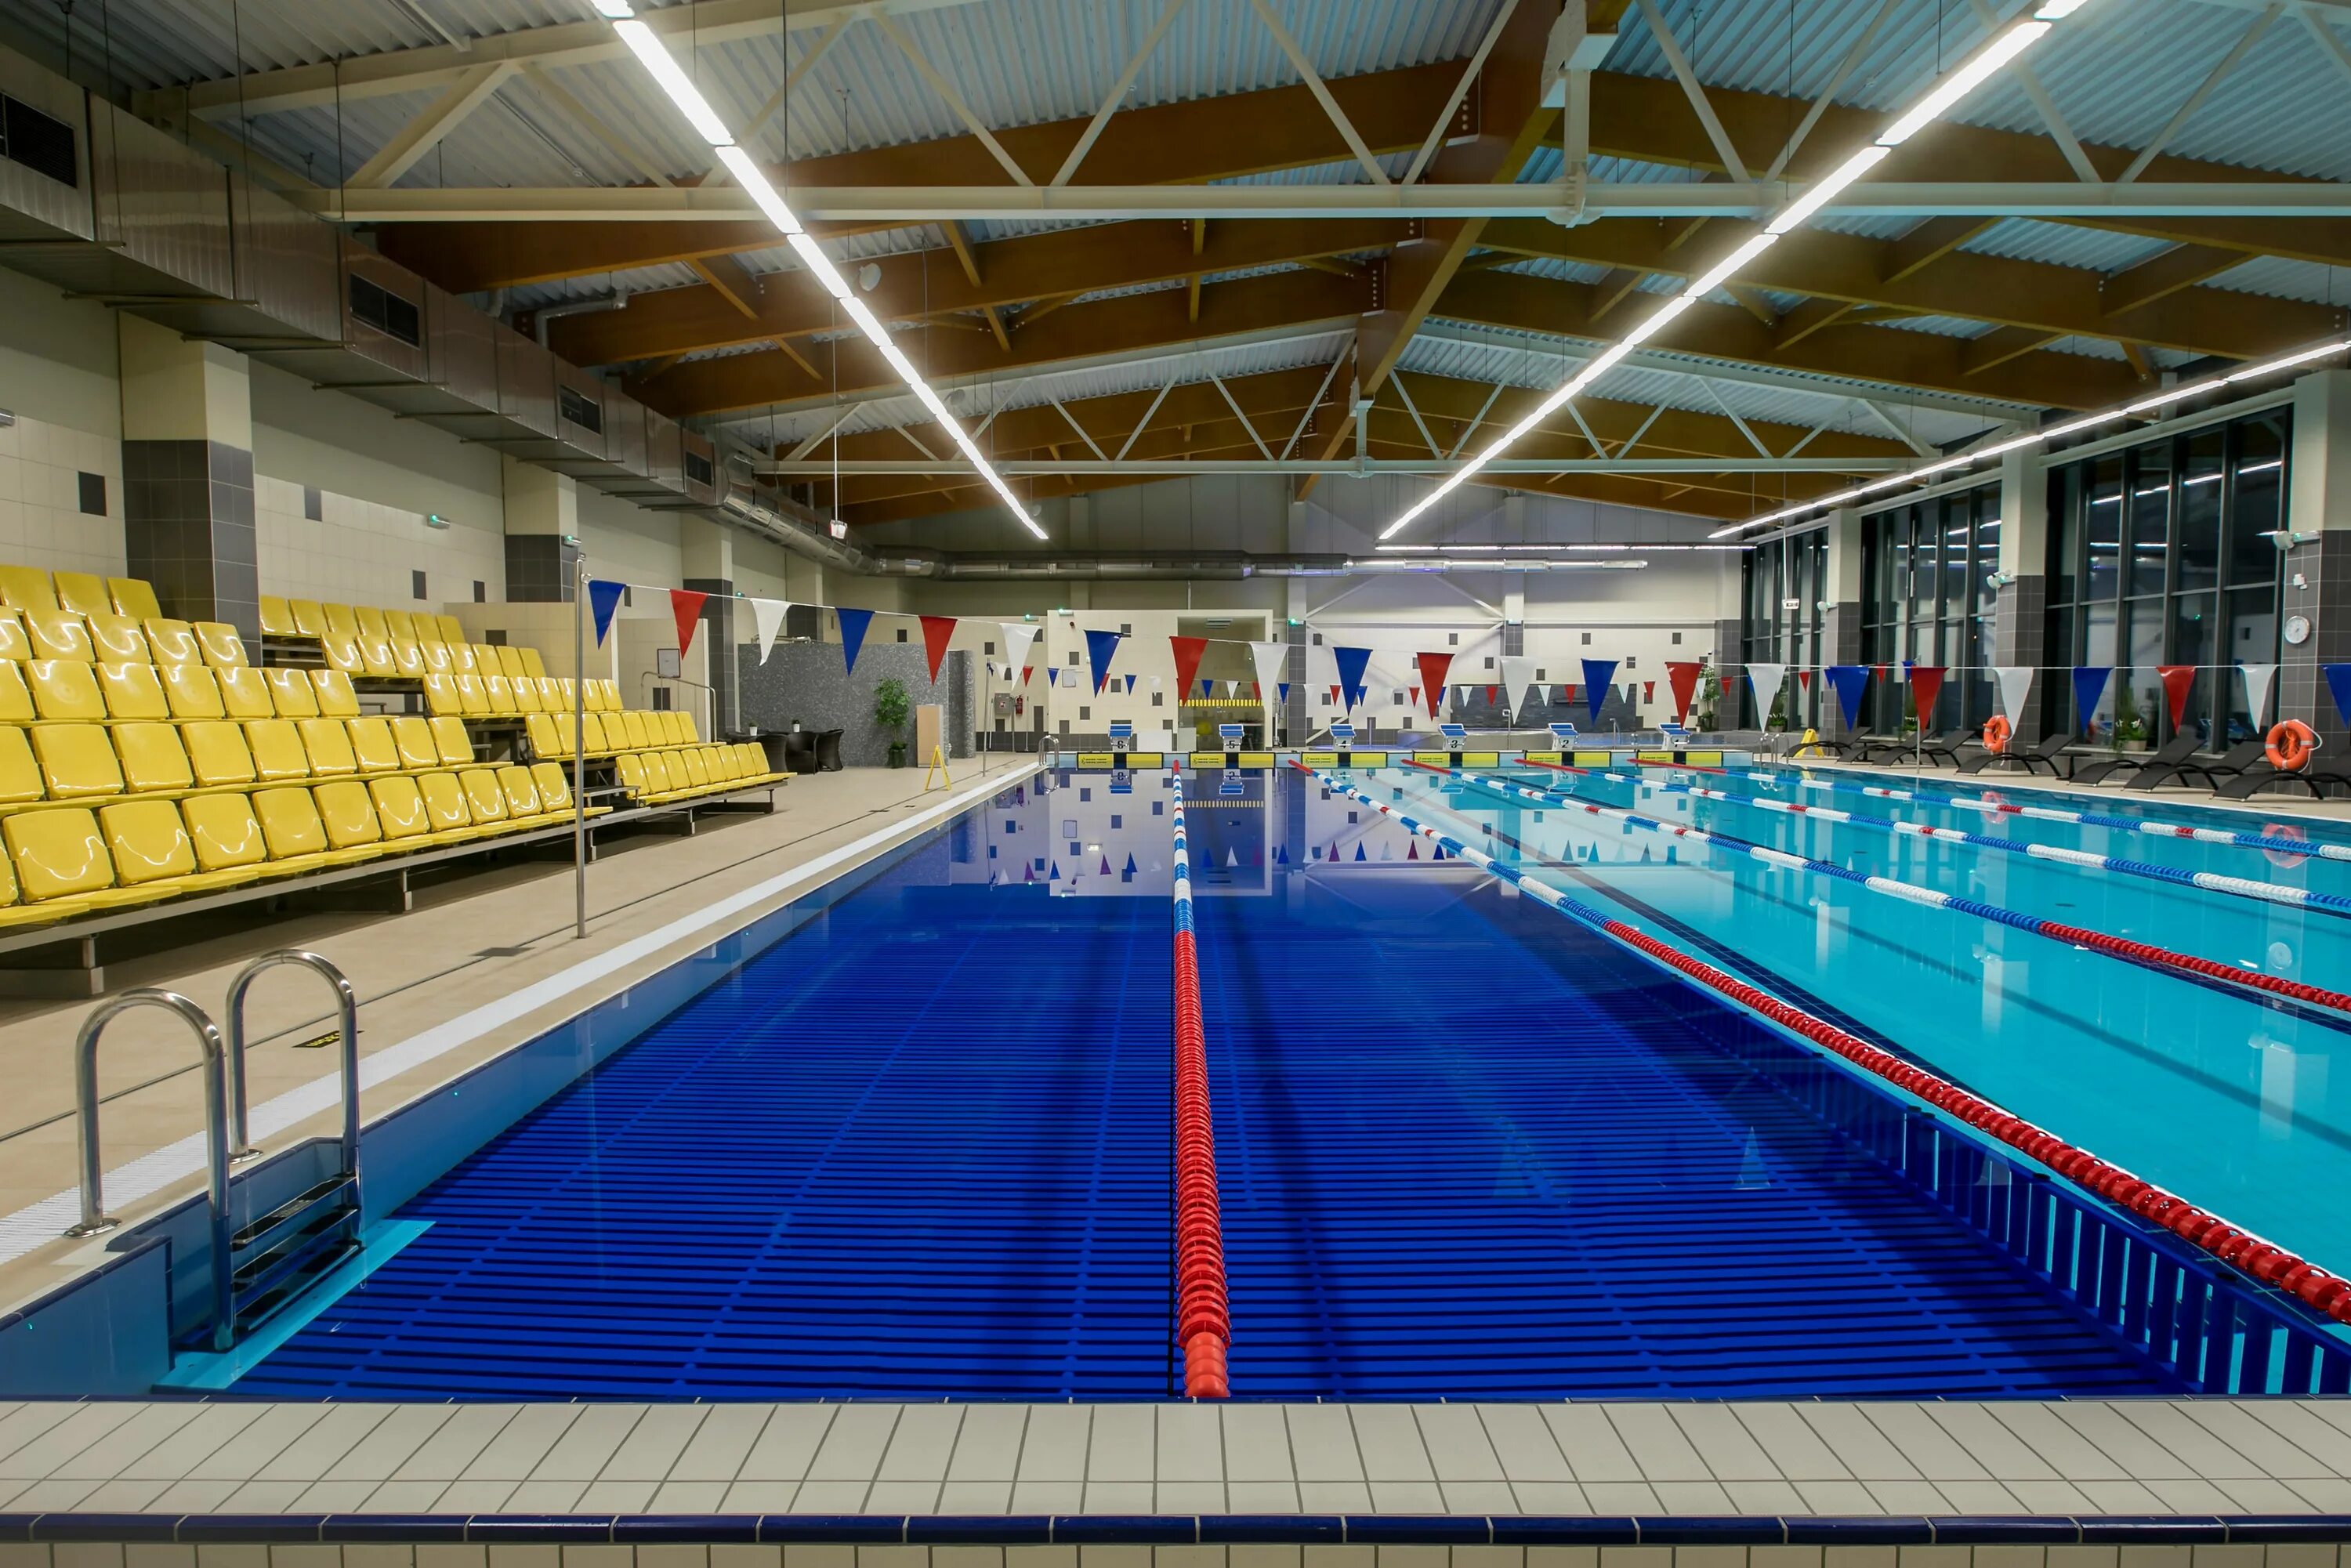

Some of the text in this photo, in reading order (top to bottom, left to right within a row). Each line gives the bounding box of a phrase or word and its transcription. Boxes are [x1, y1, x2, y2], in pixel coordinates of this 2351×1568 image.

[1117, 740, 1124, 749] 6
[1228, 740, 1236, 749] 5
[1451, 740, 1458, 748] 3
[1561, 739, 1569, 748] 2
